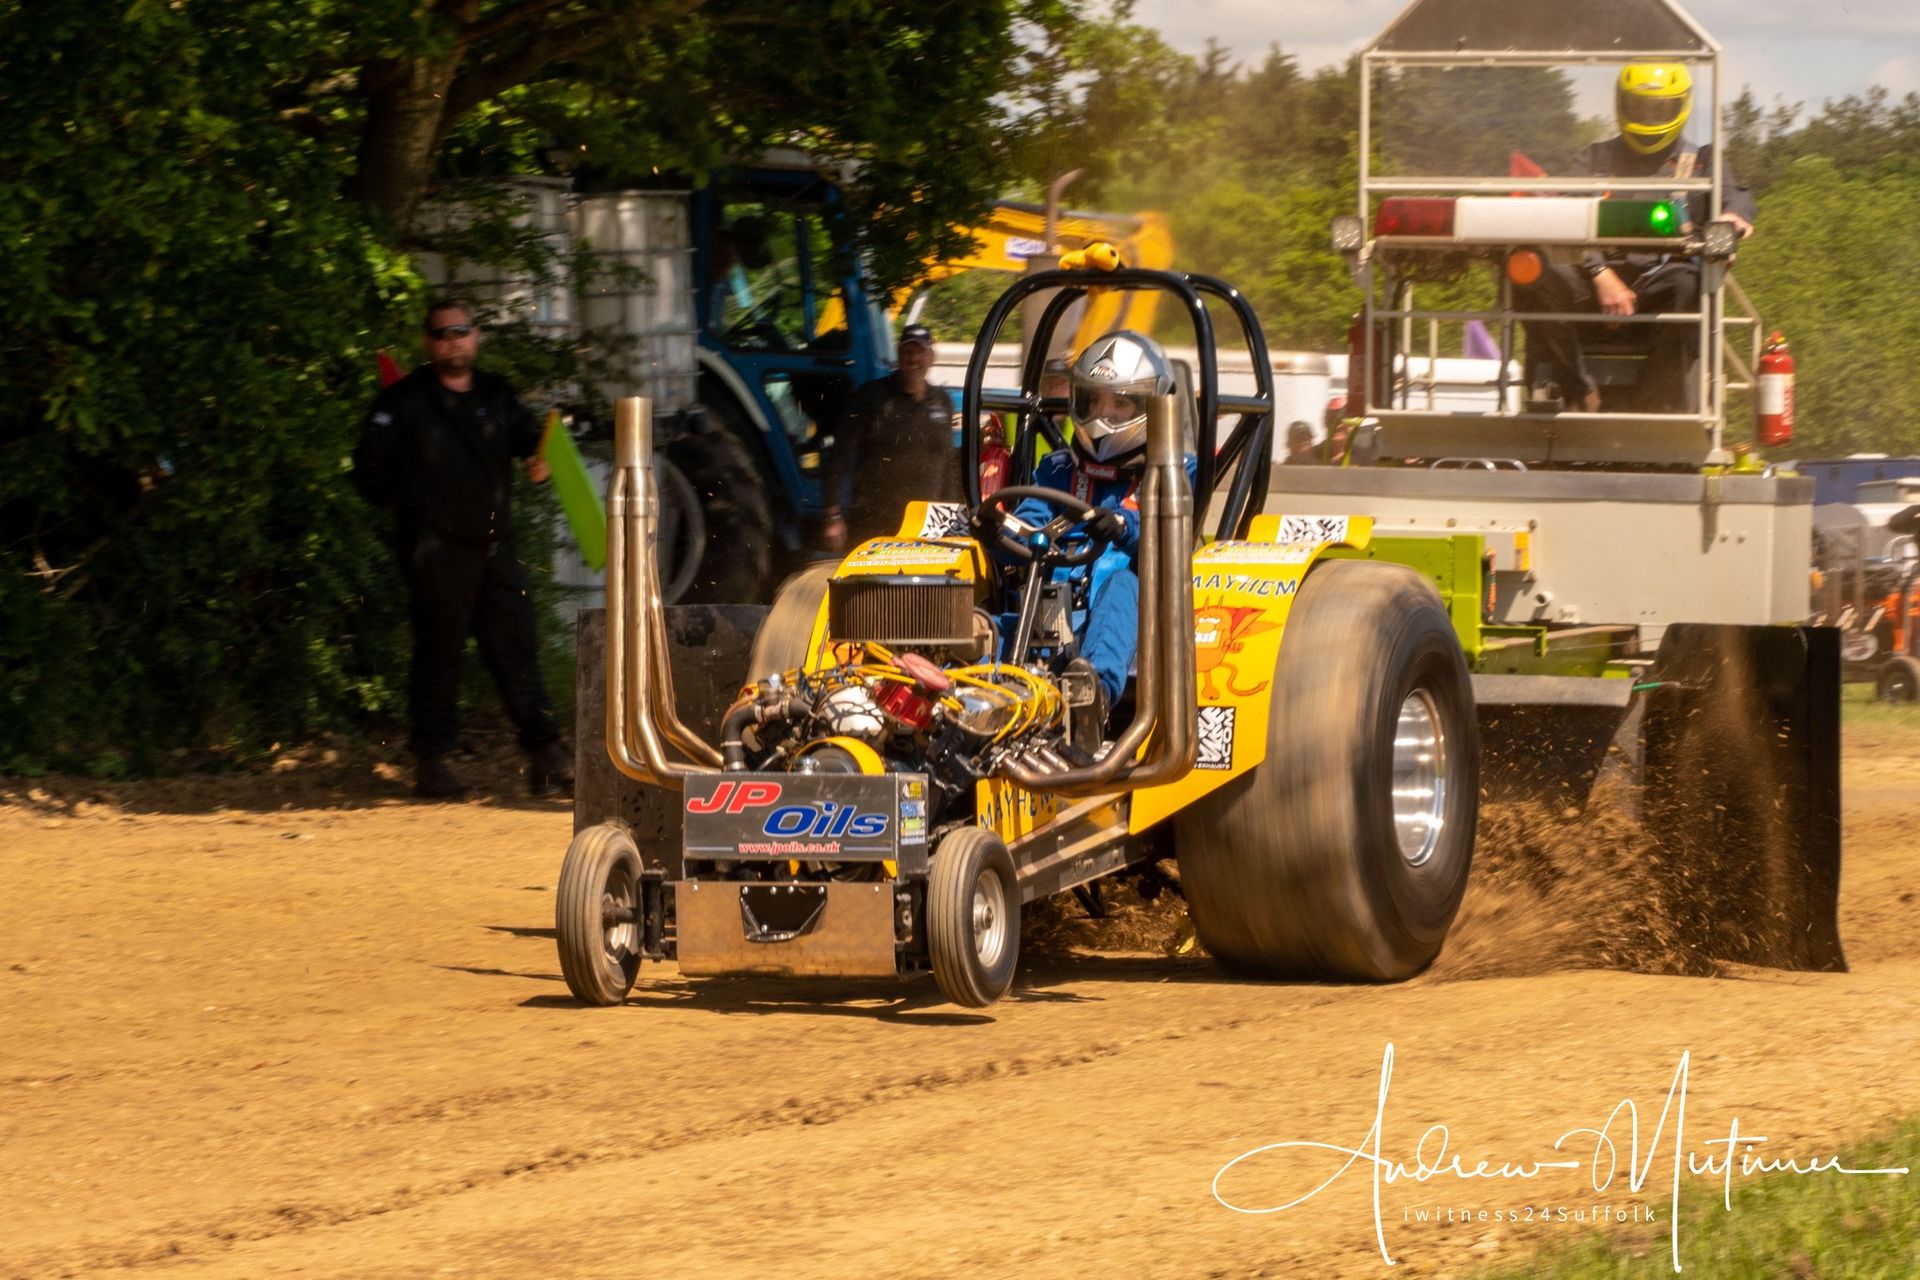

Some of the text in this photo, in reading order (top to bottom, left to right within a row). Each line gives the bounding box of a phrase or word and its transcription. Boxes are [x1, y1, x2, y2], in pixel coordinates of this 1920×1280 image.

[686, 781, 783, 814] JP
[980, 783, 1054, 831] MAYHEM
[762, 801, 890, 838] Oils
[738, 840, 841, 856] www.jpoils.co.uk
